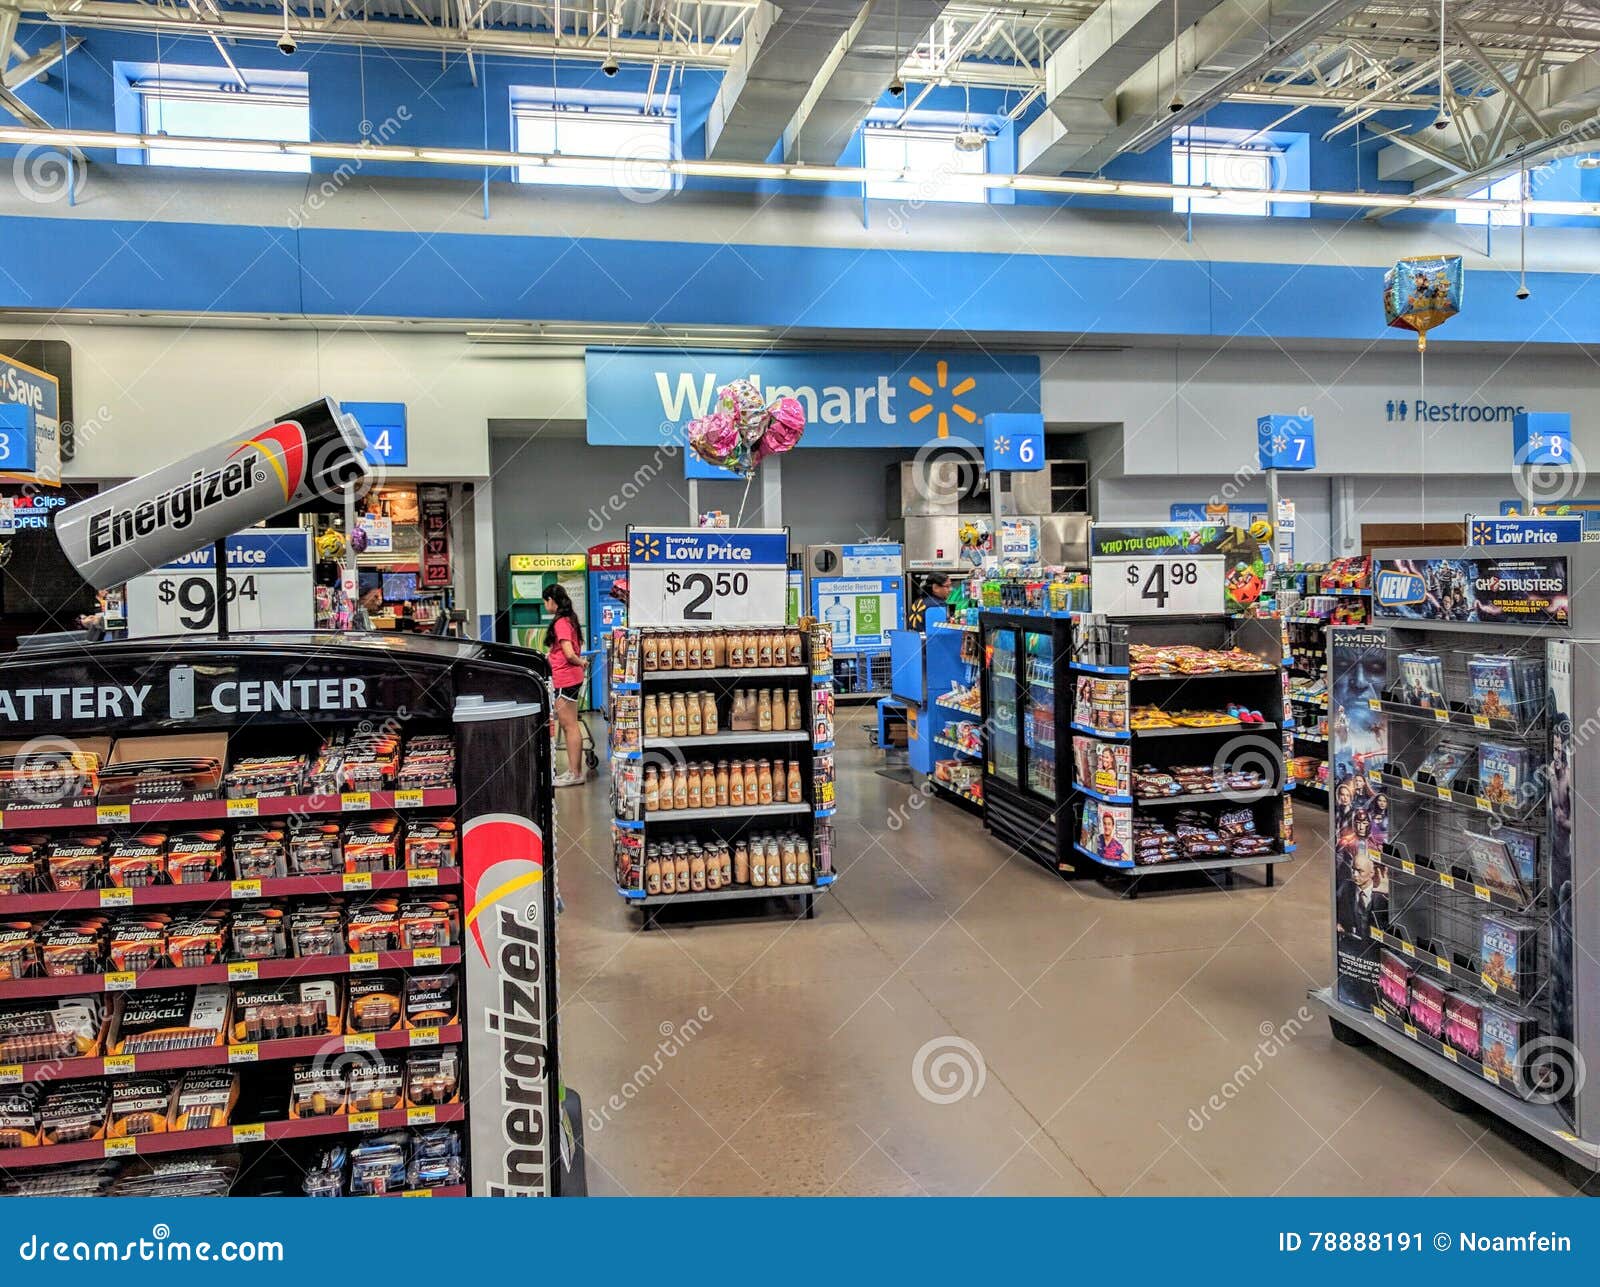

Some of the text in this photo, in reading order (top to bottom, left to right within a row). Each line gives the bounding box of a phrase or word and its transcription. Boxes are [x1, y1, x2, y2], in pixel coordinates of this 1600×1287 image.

[7, 367, 43, 411] Save
[654, 372, 897, 424] Wmart
[374, 430, 392, 457] 4
[1550, 434, 1563, 457] 8
[1018, 437, 1035, 463] 6
[1293, 438, 1306, 462] 7
[33, 496, 67, 509] Clips
[14, 516, 48, 529] OPEN
[1495, 523, 1519, 531] Everyday
[666, 536, 699, 545] Everyday
[1495, 528, 1558, 544] Low Price
[1101, 535, 1179, 554] WHO YOU GONNA
[168, 545, 267, 565] ow rice
[665, 543, 752, 560] Low Price
[533, 556, 577, 568] coinstar
[429, 567, 446, 579] 22
[832, 583, 855, 592] Bottle
[855, 582, 880, 591] Return
[1380, 576, 1411, 601] NEW
[1475, 577, 1563, 592] GHOSTBUSTERS
[859, 598, 877, 606] ZERO
[0, 677, 367, 722] ATTERY CENTER
[349, 834, 389, 844] Energizer
[52, 846, 98, 858] Energizer
[114, 846, 159, 857] Energizer
[174, 842, 218, 853] Energizer
[0, 854, 29, 865] rgizer
[352, 913, 394, 924] Energizer
[0, 930, 29, 940] rgizer
[47, 935, 93, 946] Energizer
[115, 930, 160, 941] Energizer
[1363, 959, 1381, 967] HOM
[350, 984, 385, 993] DURACELL
[236, 993, 284, 1005] DURACELL
[409, 992, 442, 1001] DURACELL
[123, 1007, 185, 1022] DURACELL
[0, 1018, 45, 1030] RACELL
[294, 1067, 342, 1081] DURACELL
[352, 1064, 399, 1077] DURACELL
[183, 1079, 231, 1091] DURACELL
[113, 1085, 163, 1098] DURACELL
[0, 1103, 29, 1113] ACELL
[41, 1104, 96, 1118] DURACELL
[132, 1101, 143, 1109] 10
